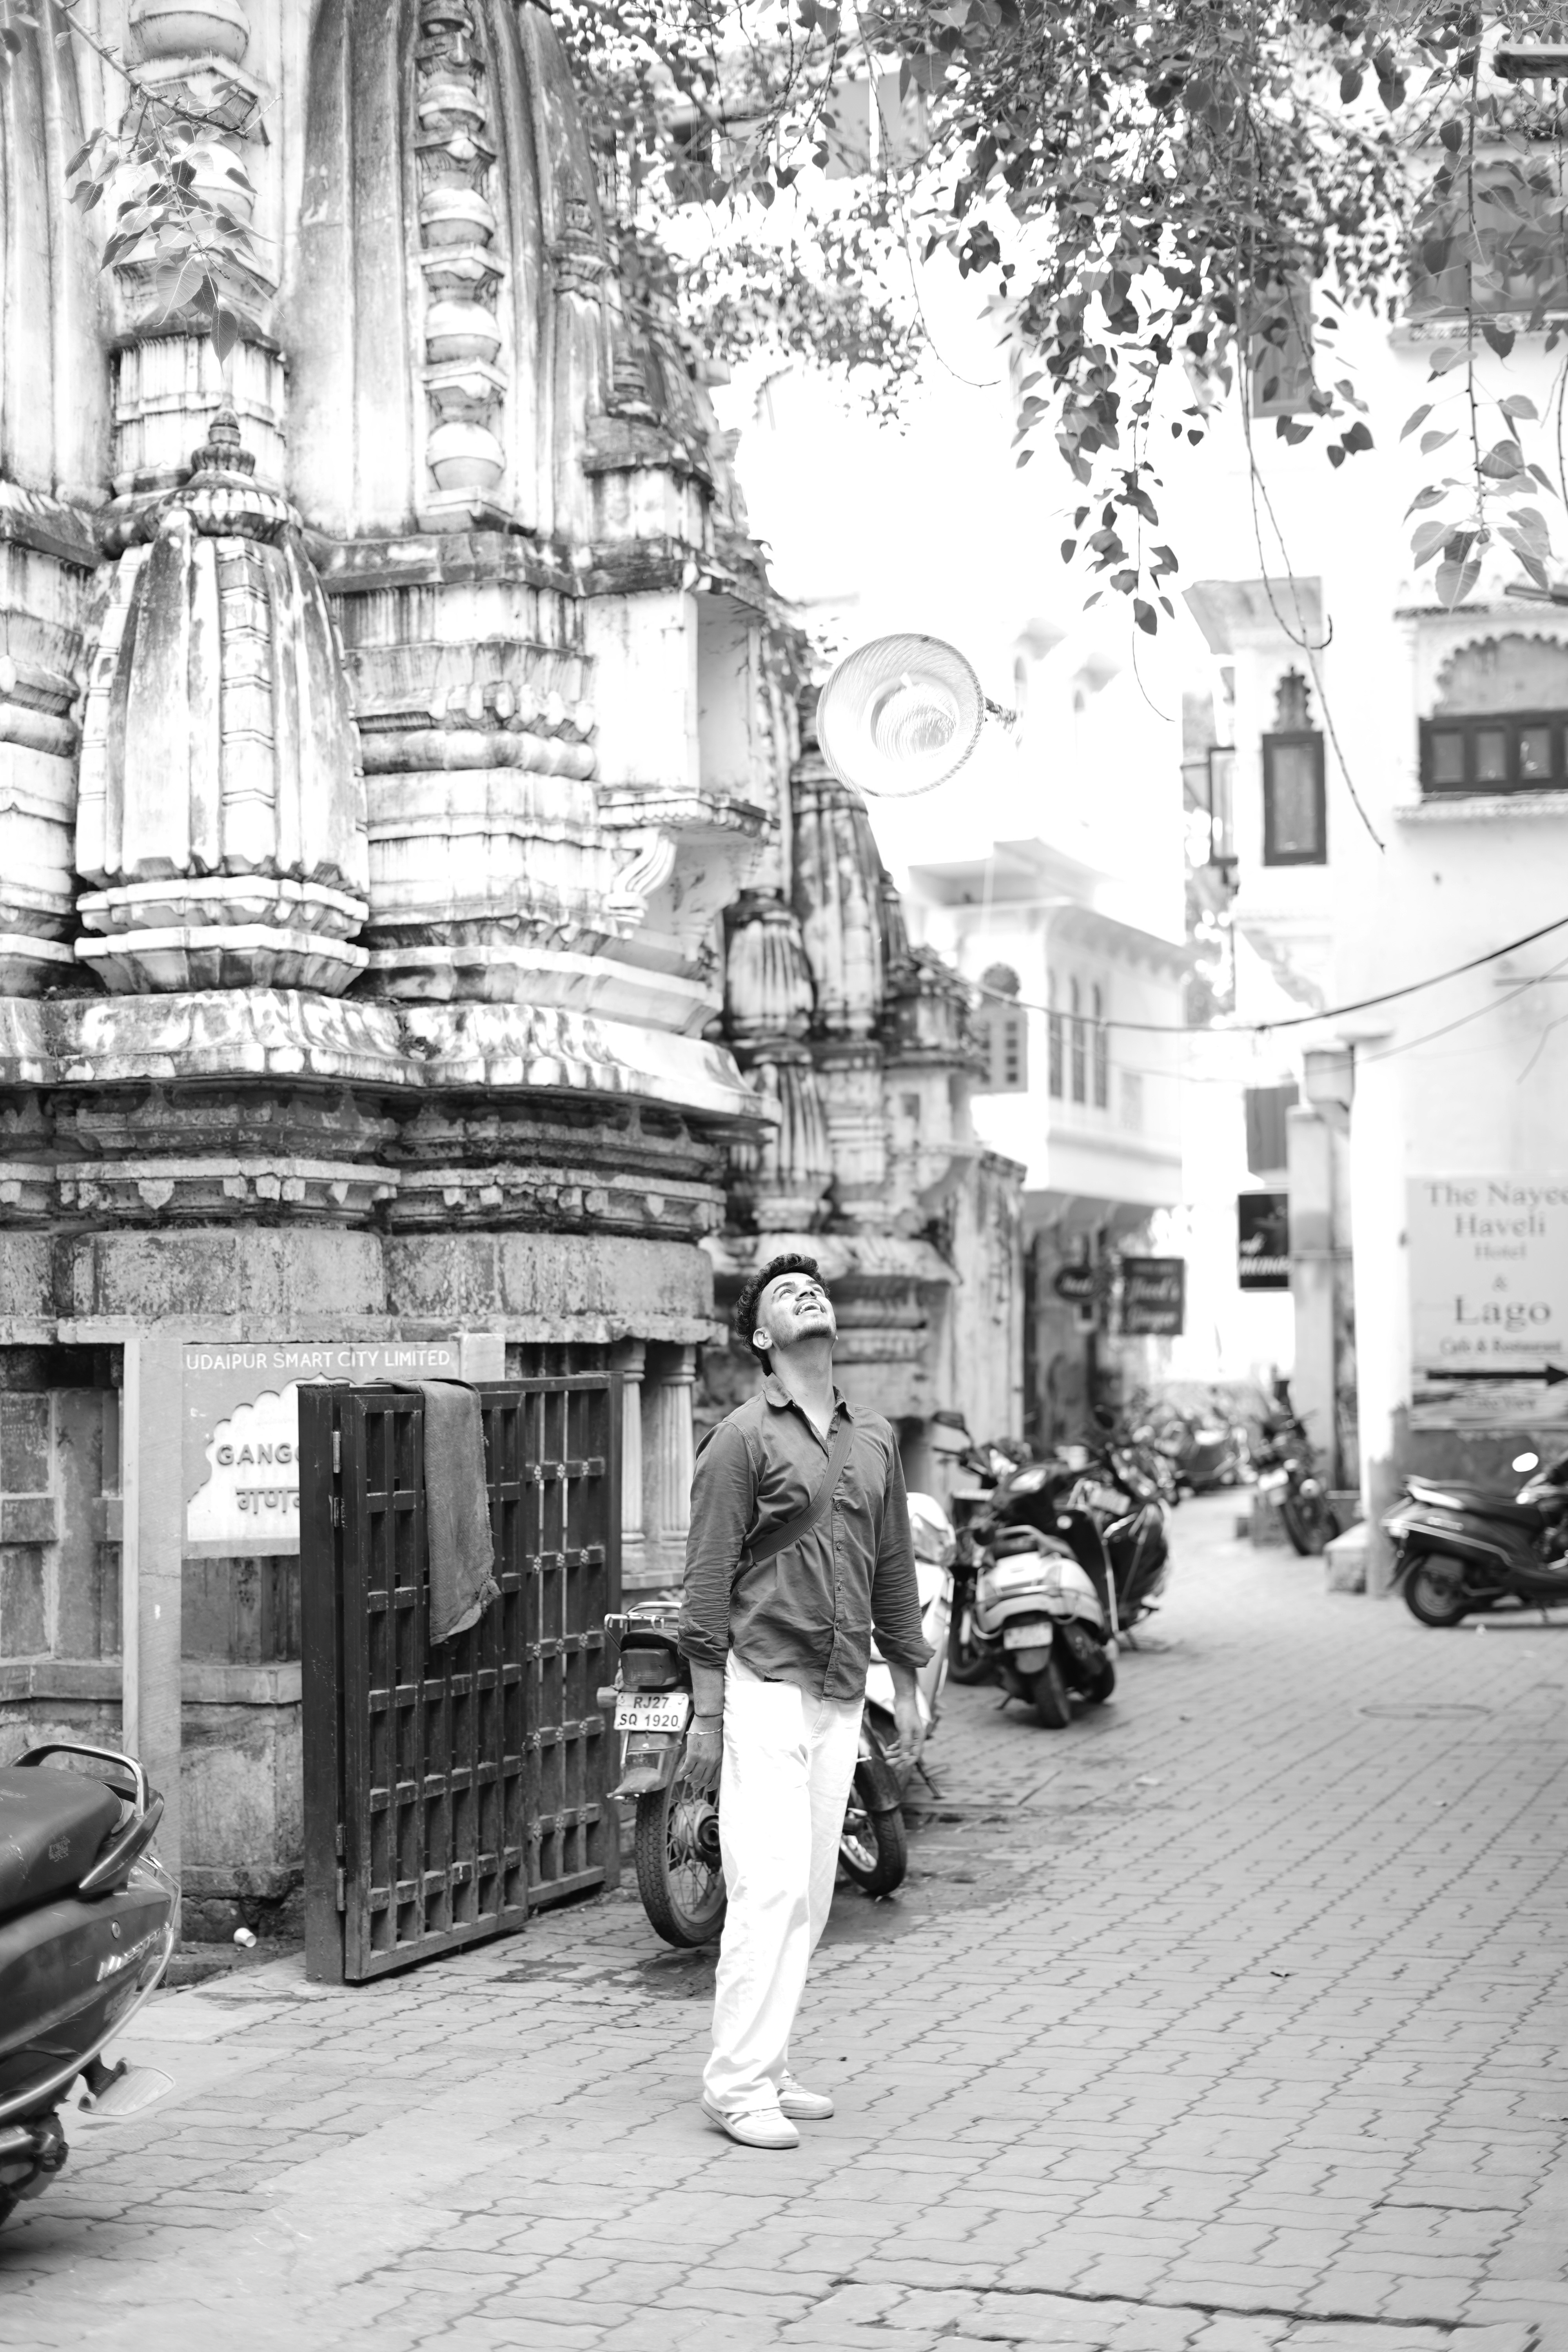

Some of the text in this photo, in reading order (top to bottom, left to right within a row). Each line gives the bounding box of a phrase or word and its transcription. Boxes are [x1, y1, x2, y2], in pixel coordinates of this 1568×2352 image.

[1424, 1181, 1478, 1206] The
[1455, 1212, 1546, 1237] Haveli
[1455, 1295, 1551, 1333] Lago
[186, 1350, 450, 1370] UDAIPUR SMART CITY LIMITED
[216, 1442, 299, 1466] GANG
[634, 1697, 670, 1709] RJ27
[620, 1713, 679, 1727] SQ 1920
